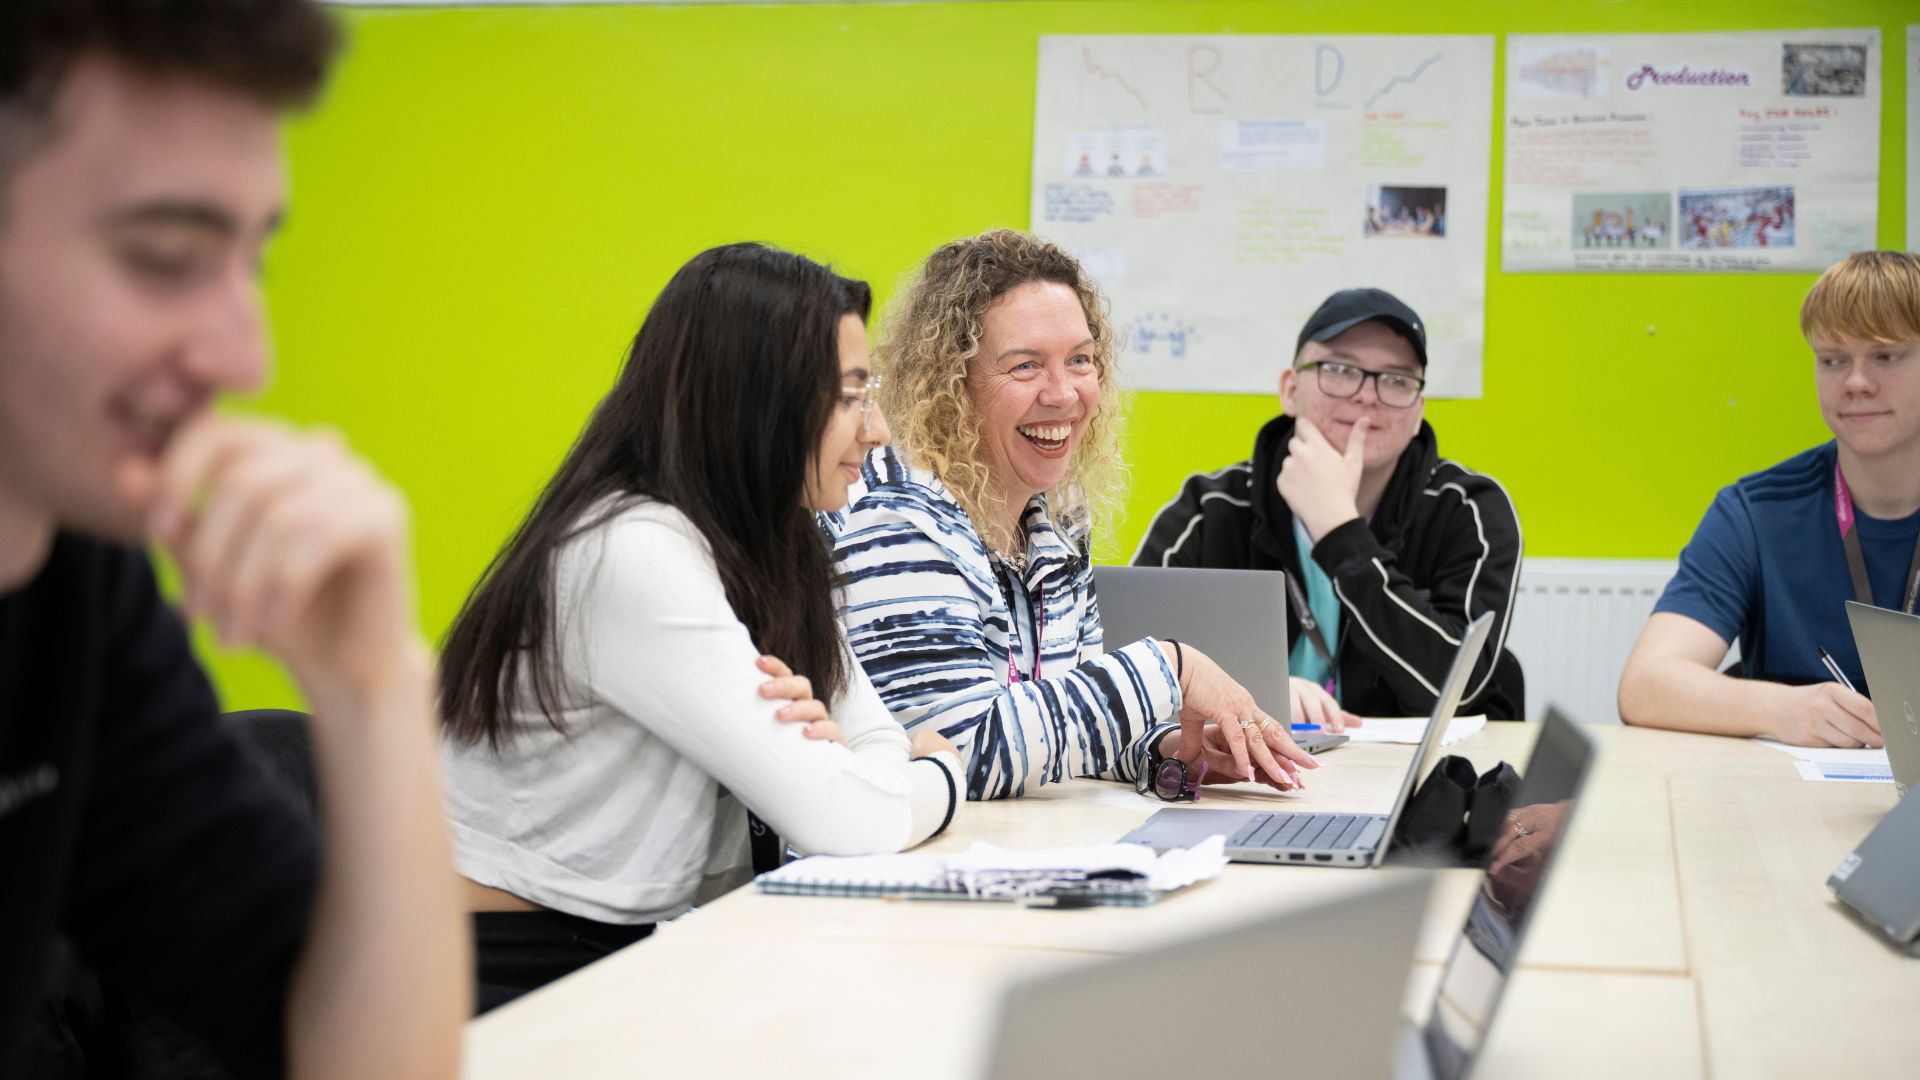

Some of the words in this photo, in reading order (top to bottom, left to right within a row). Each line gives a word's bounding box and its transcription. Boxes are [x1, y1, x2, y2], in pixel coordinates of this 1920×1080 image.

[1187, 44, 1229, 105] R
[1314, 42, 1345, 97] D
[1626, 64, 1750, 91] Production
